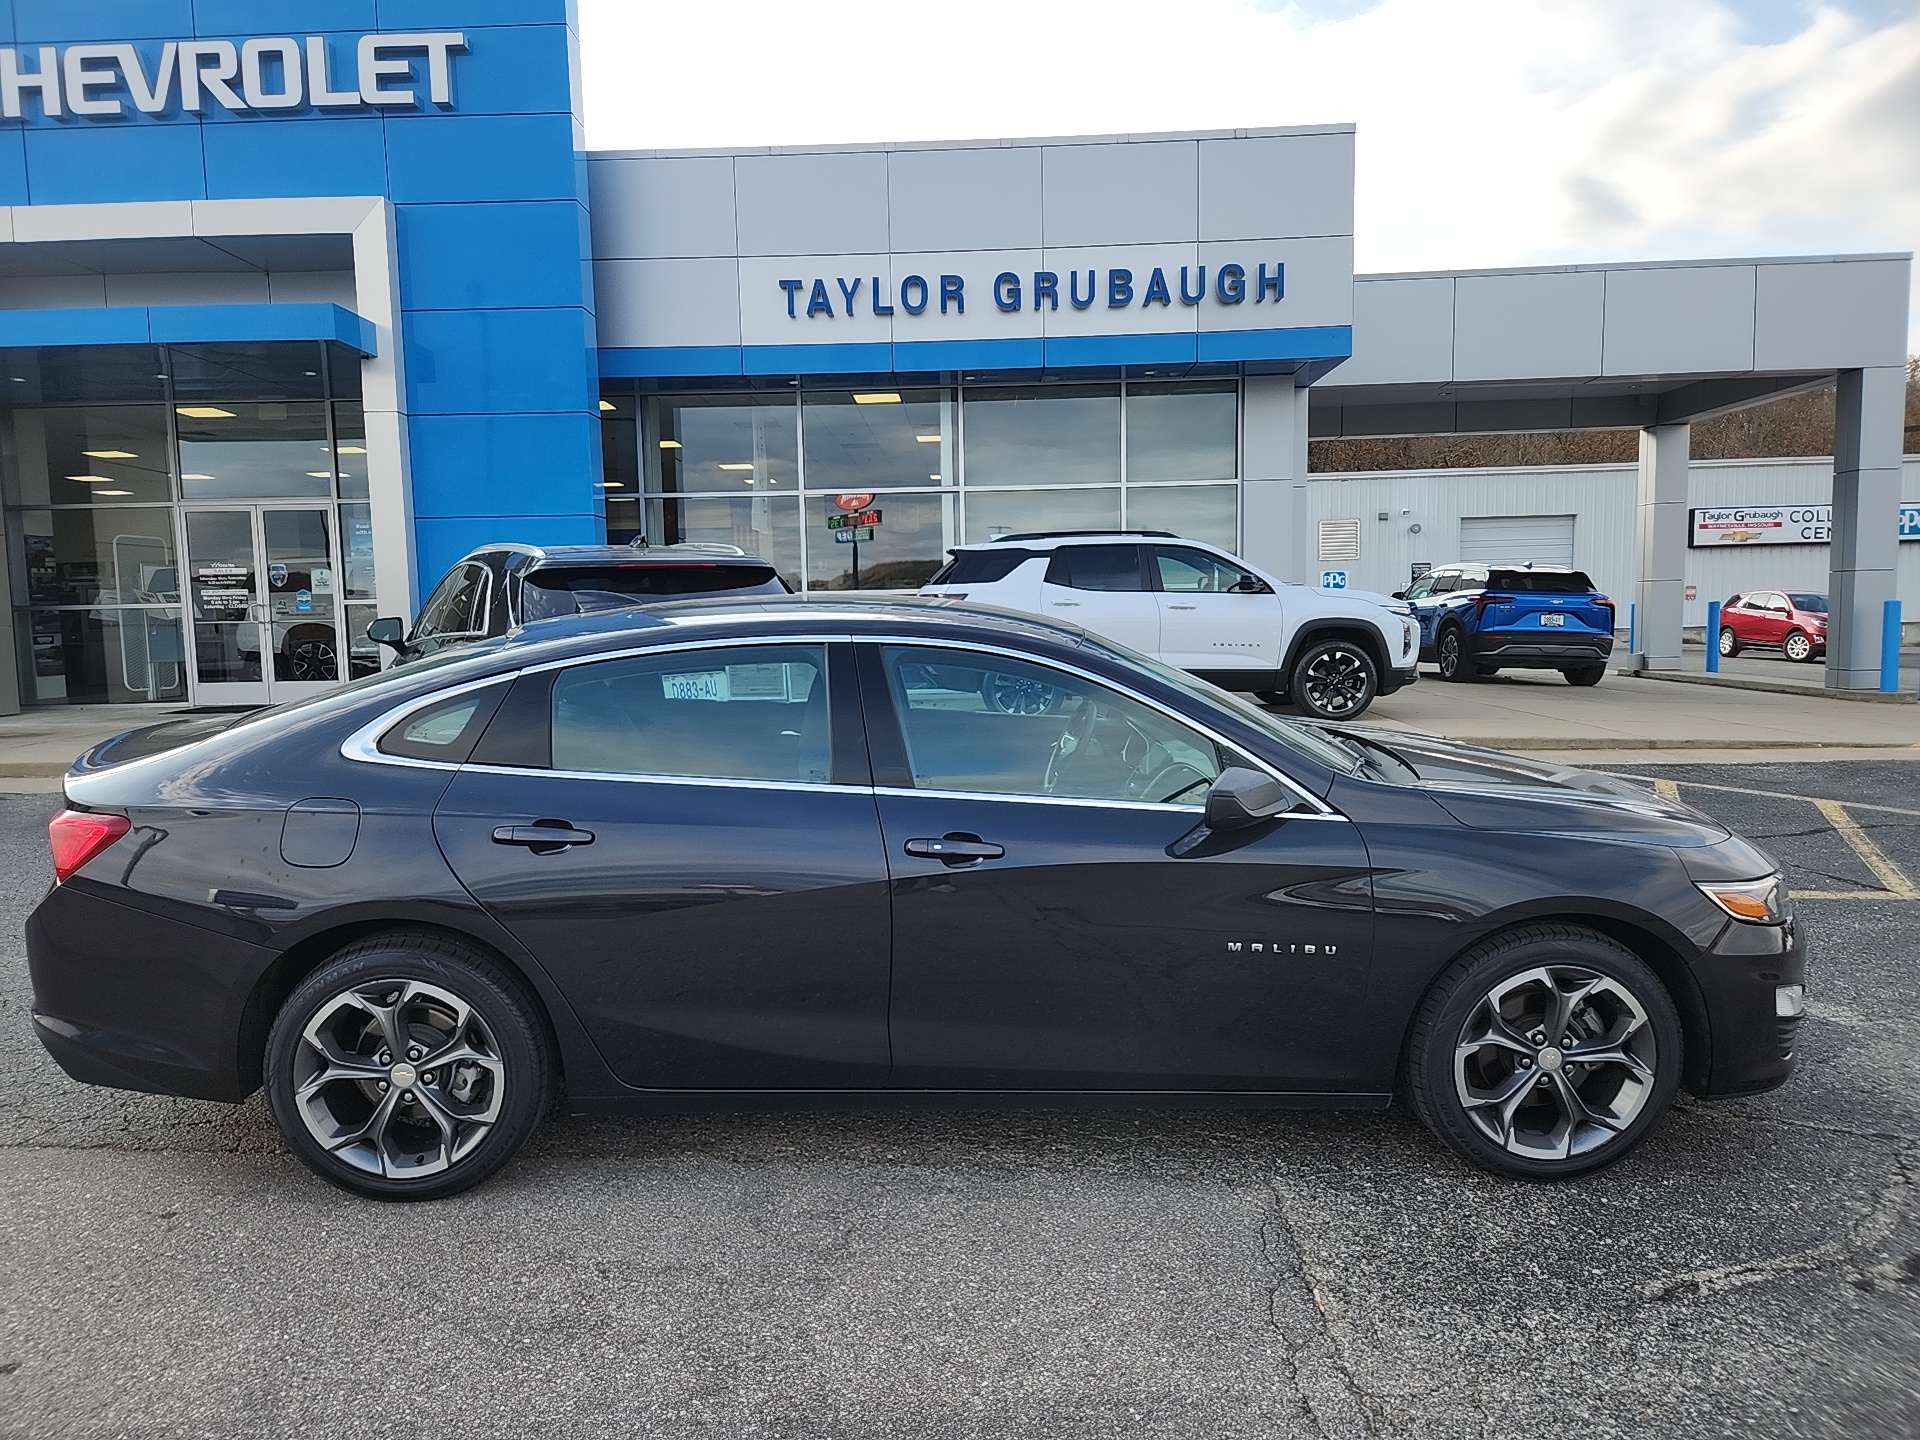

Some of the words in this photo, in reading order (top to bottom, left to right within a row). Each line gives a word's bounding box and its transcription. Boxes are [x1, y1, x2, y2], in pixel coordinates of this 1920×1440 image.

[0, 32, 468, 119] HEVROLET
[779, 273, 966, 318] TAYLOR
[993, 262, 1285, 312] GRUBAUGH
[1699, 511, 1732, 523] Taylor
[1734, 510, 1783, 522] Grubaugh
[1323, 573, 1345, 588] PPG
[671, 679, 718, 699] D883-AU
[1227, 942, 1337, 955] MALIBU
